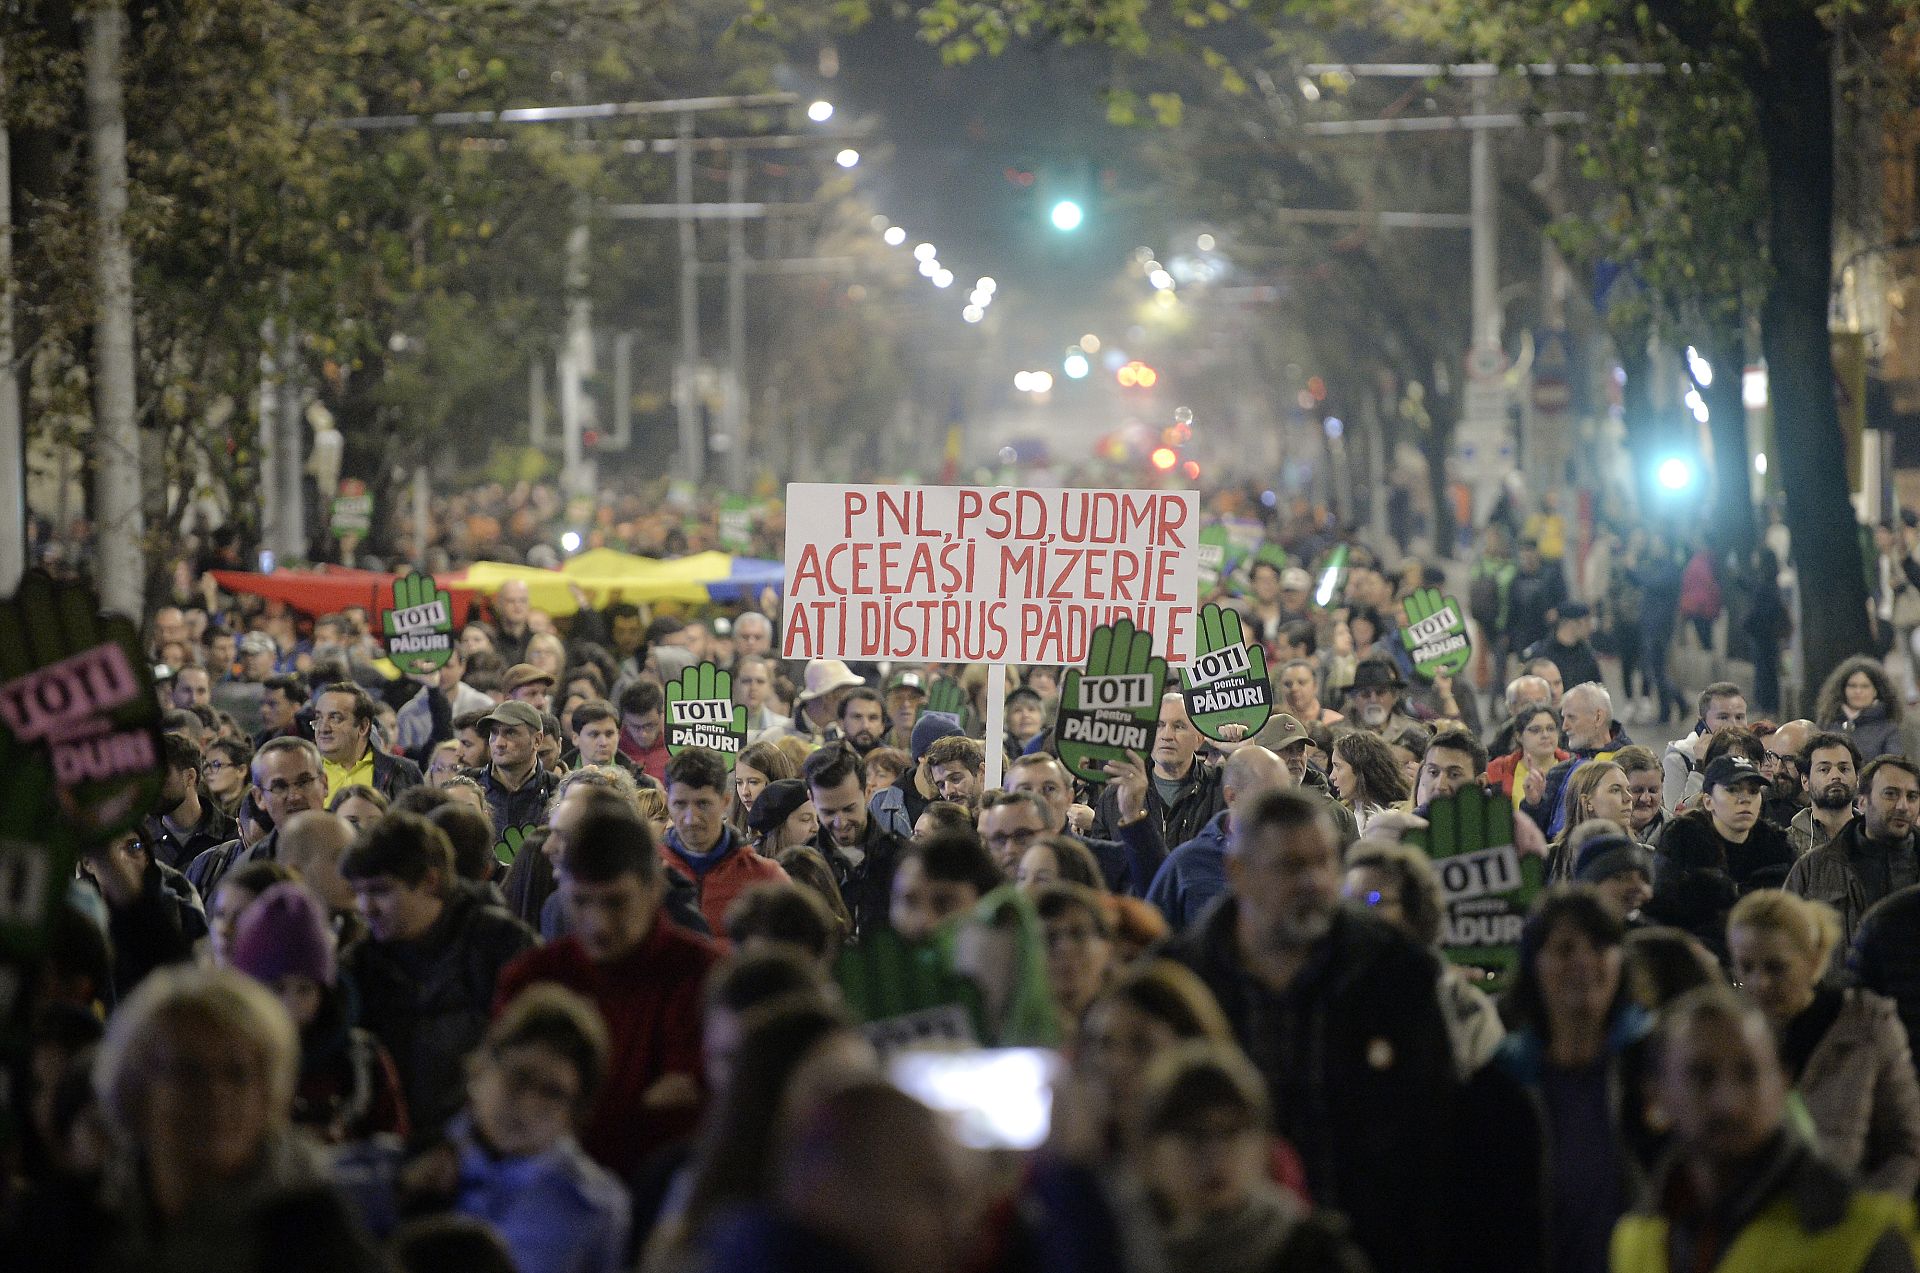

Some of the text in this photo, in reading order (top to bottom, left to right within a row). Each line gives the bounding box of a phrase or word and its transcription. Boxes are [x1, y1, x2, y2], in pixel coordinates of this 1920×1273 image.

[1214, 677, 1245, 691] pentru
[1192, 686, 1264, 713] PĂDURI
[672, 728, 740, 752] PĂDURI
[695, 724, 725, 734] pentru
[1063, 716, 1147, 749] PĂDURI
